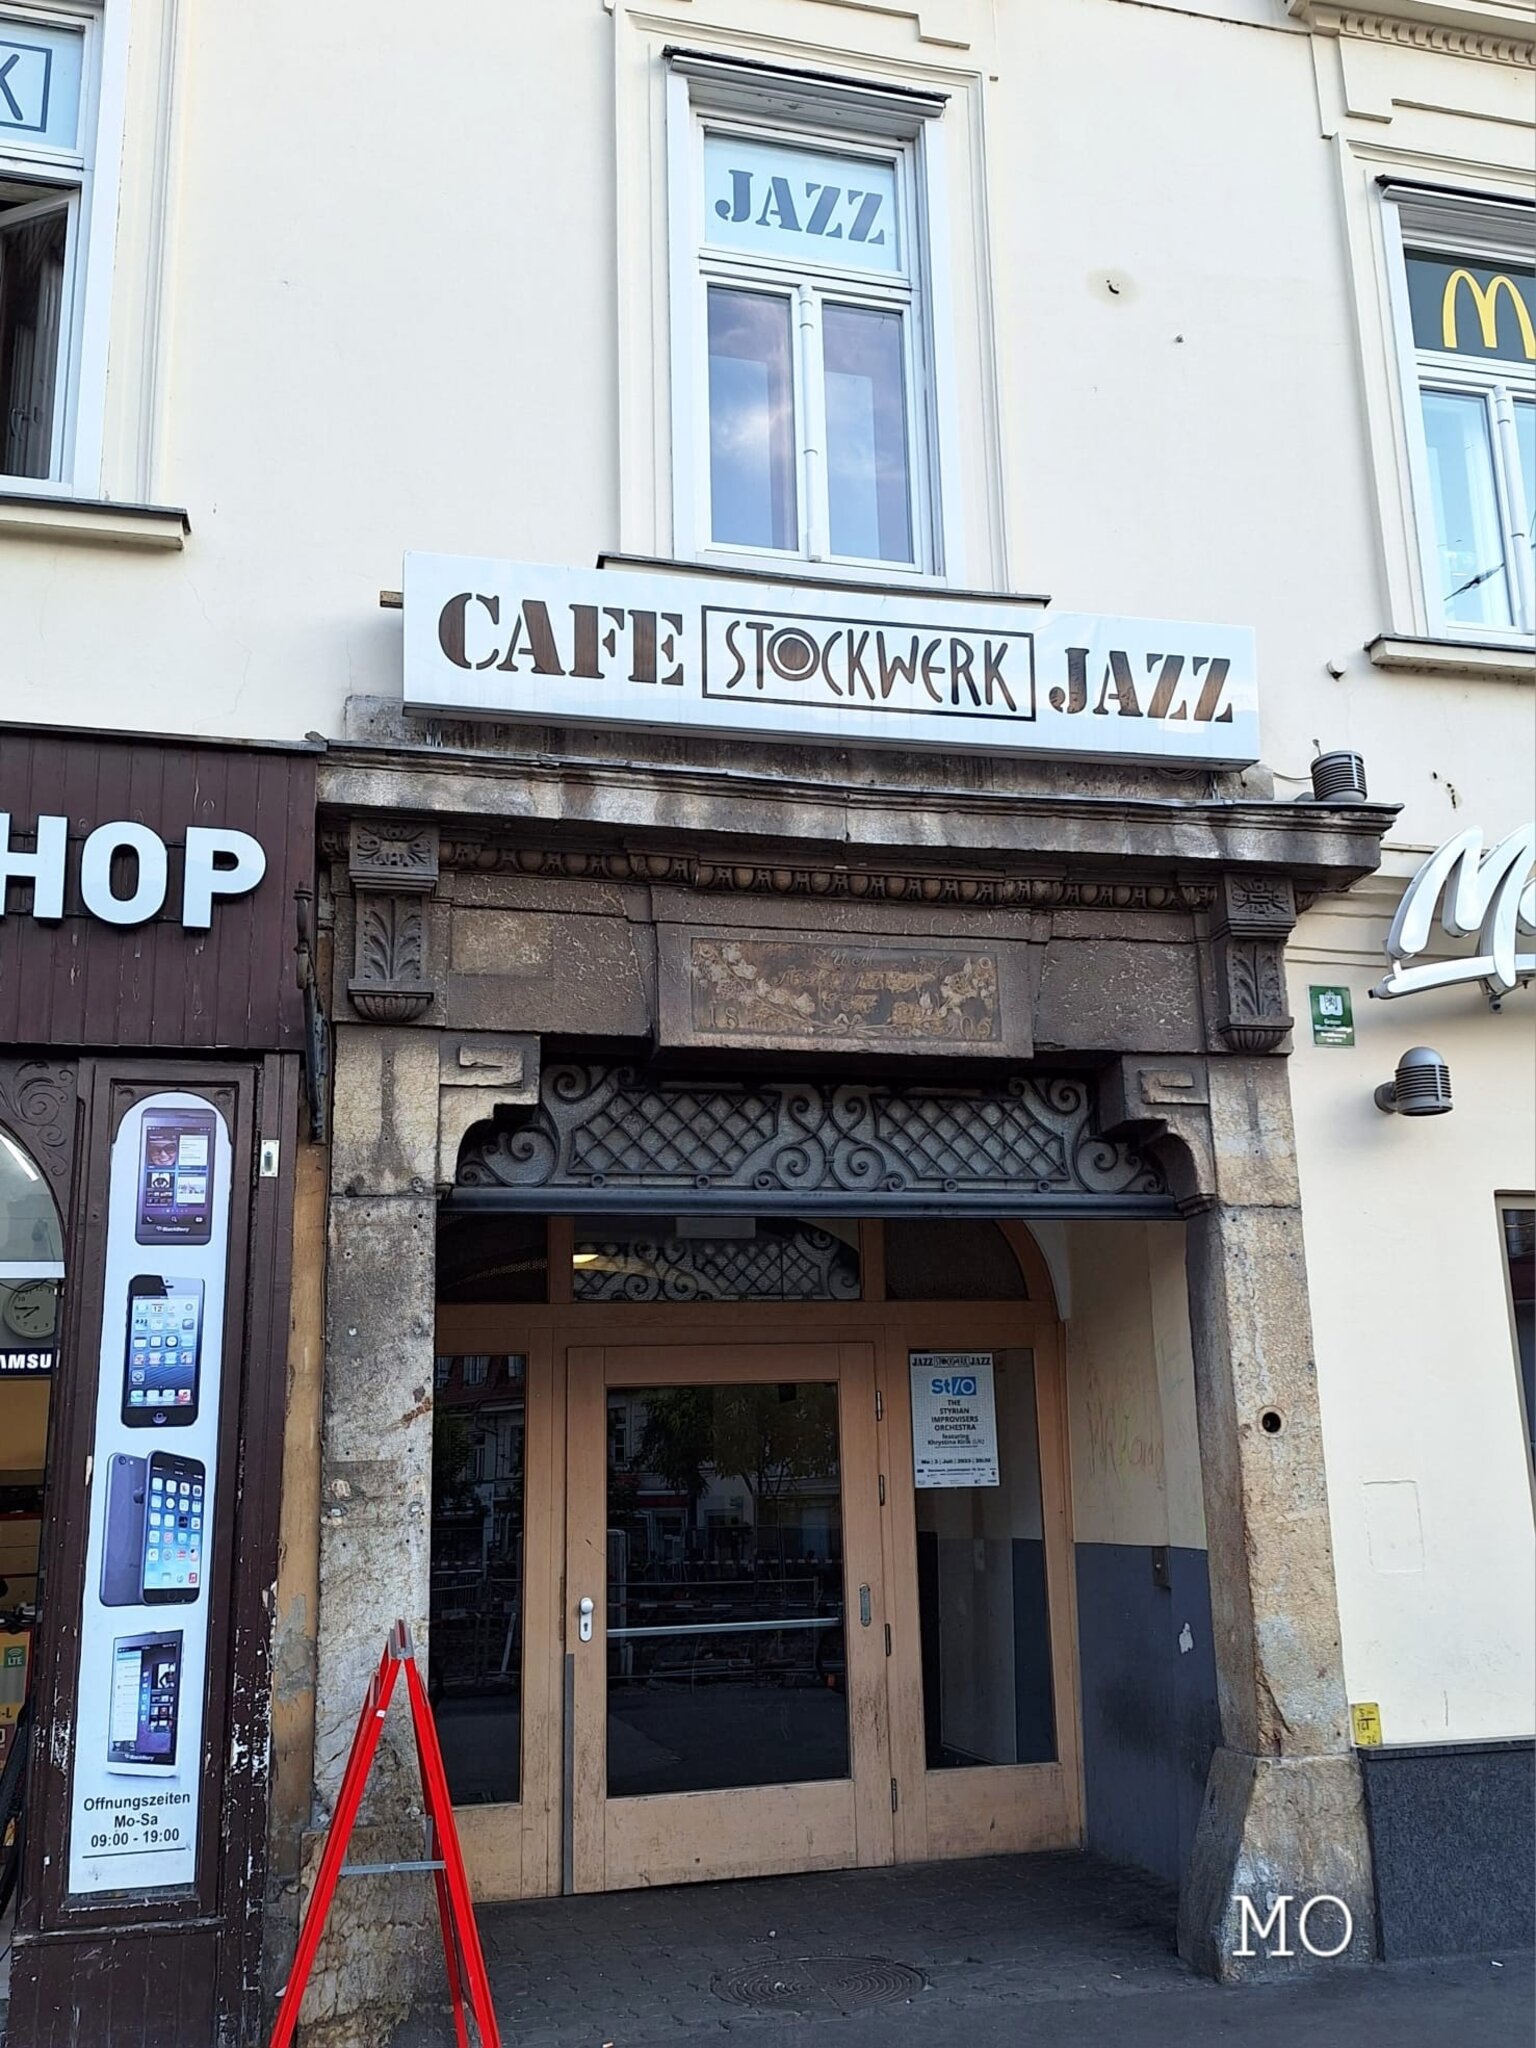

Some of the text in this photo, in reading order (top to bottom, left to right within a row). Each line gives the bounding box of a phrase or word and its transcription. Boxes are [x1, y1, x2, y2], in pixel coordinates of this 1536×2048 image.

[714, 169, 885, 245] JAZZ
[438, 592, 1233, 724] CAFE STOCKWERK JAZZ
[0, 812, 267, 929] HOP
[931, 1415, 979, 1423] IMPROVISERS
[8, 1656, 22, 1666] LTE
[114, 1813, 159, 1828] Mo-Sa
[91, 1832, 129, 1848] 09:00
[143, 1828, 180, 1844] 19:00
